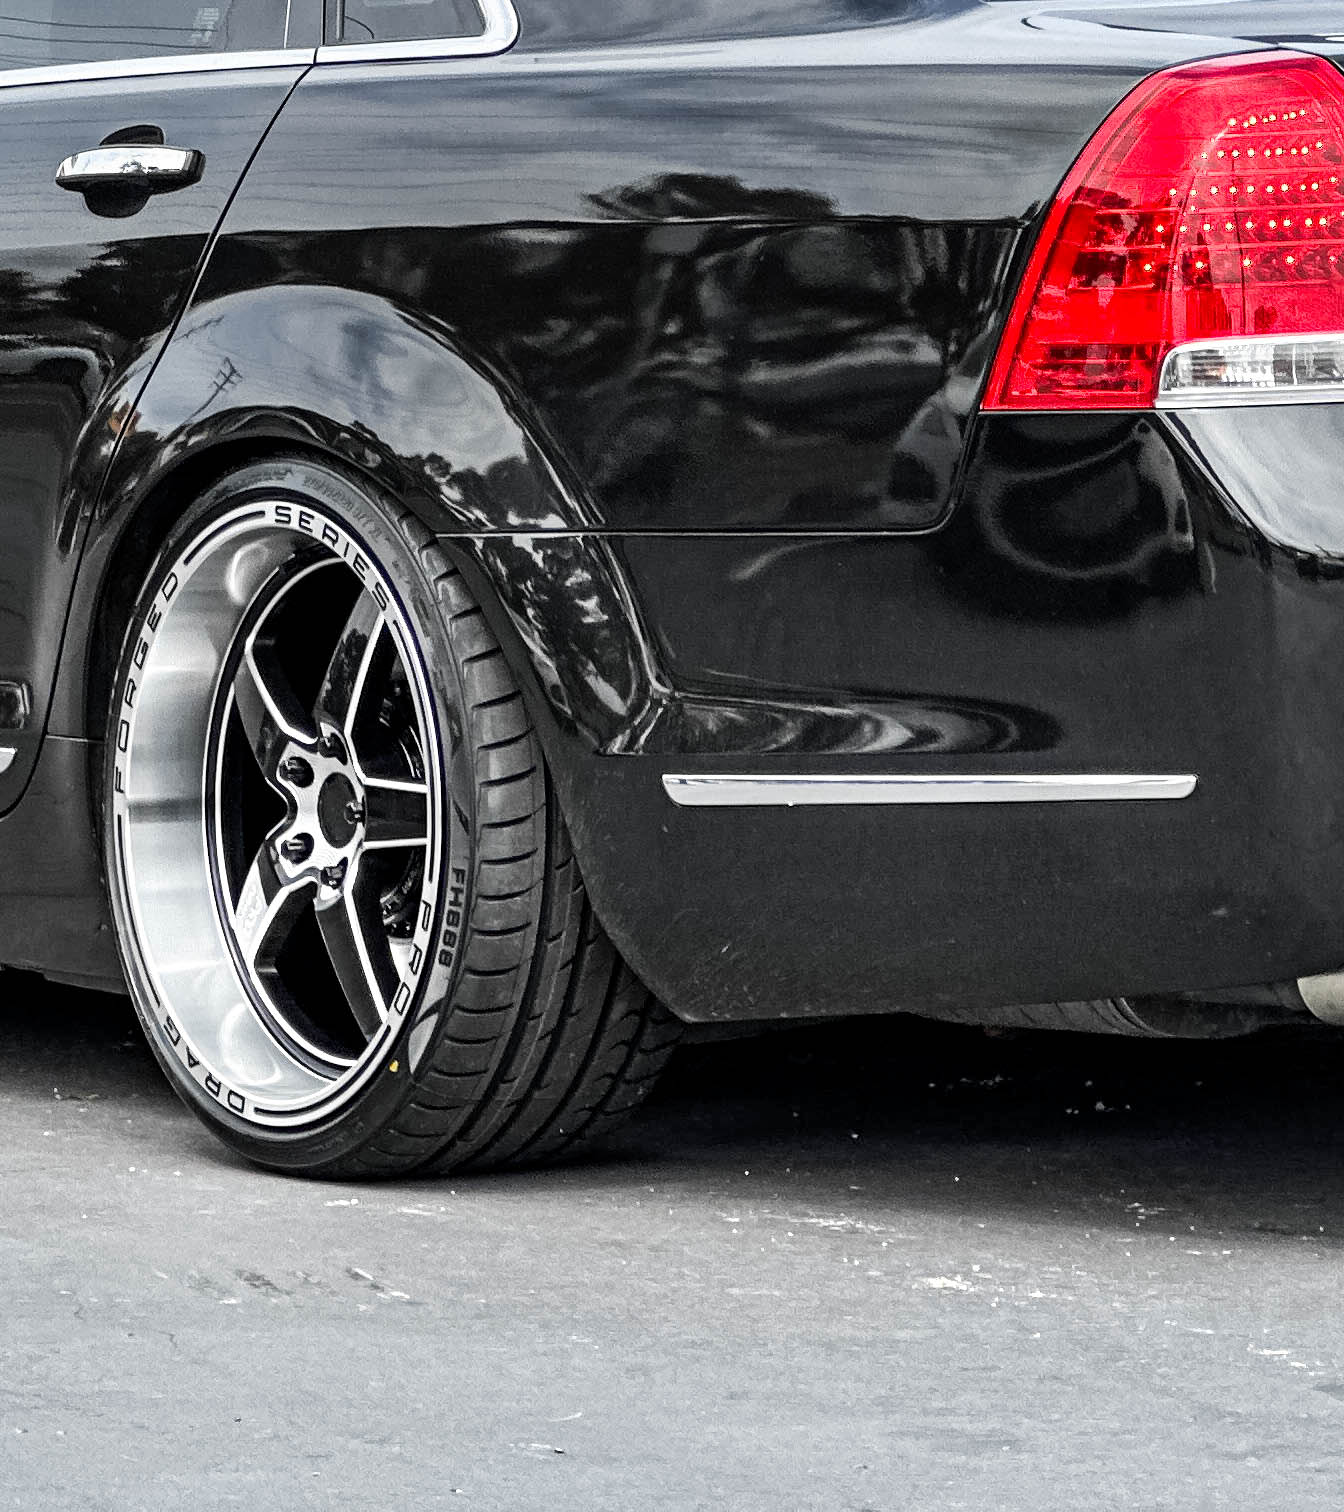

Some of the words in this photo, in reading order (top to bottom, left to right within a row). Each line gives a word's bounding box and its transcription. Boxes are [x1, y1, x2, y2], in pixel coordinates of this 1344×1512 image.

[274, 505, 390, 611] SERIES
[114, 571, 179, 794] FORGED
[394, 899, 432, 1016] PRO
[163, 1014, 246, 1113] DRAG
